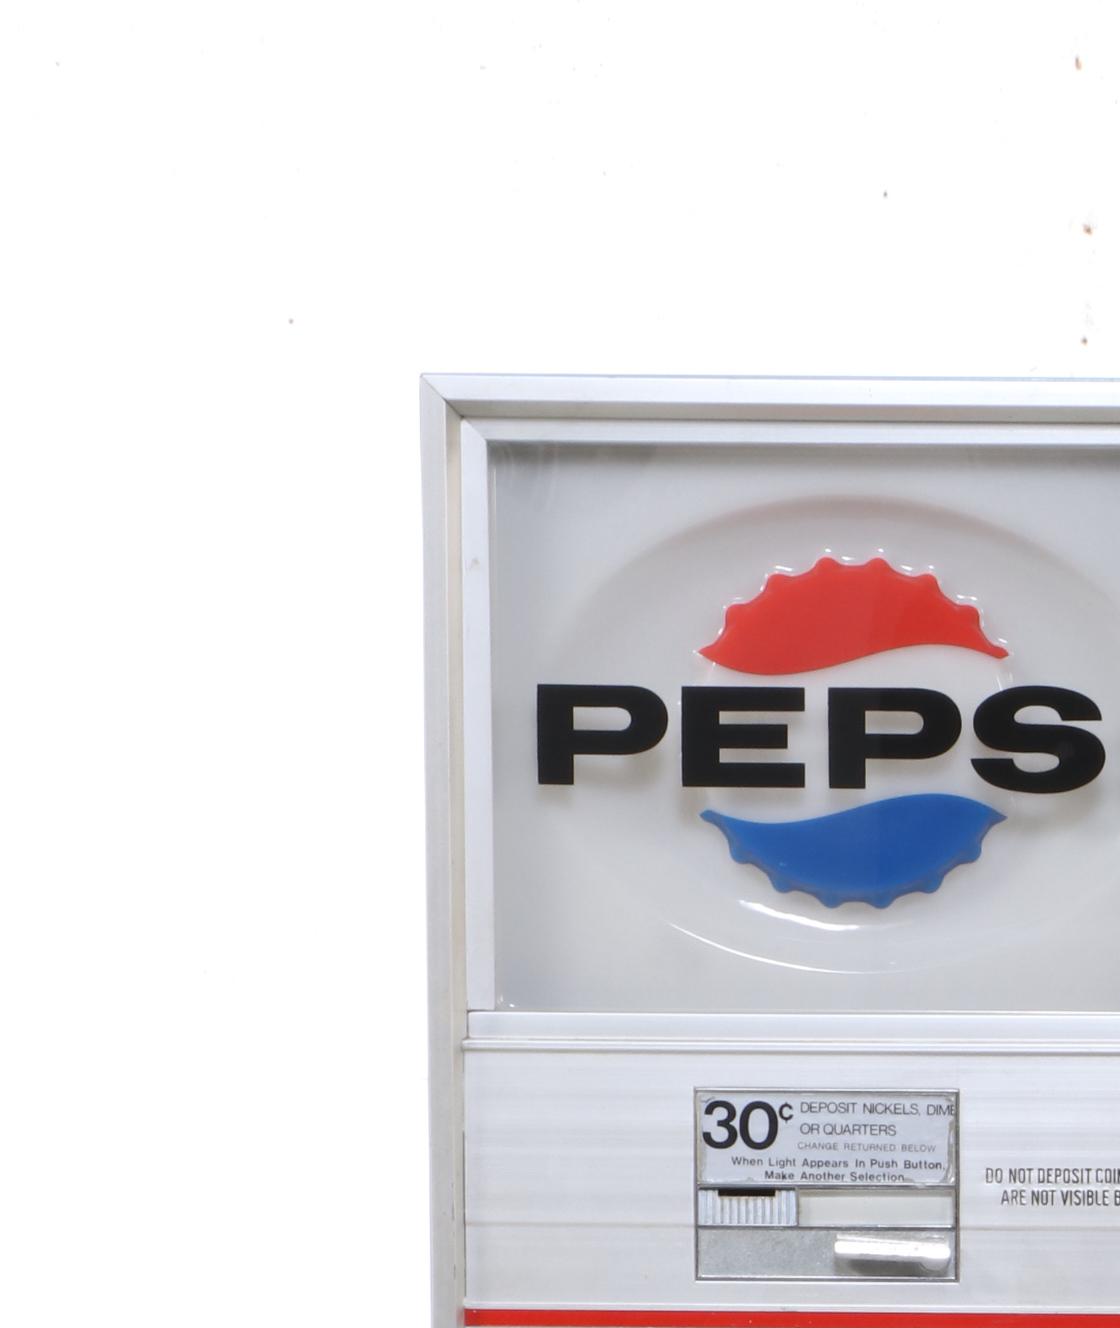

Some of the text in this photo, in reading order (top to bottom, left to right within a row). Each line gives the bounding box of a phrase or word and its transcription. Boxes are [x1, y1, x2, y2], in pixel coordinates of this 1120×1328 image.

[800, 1101, 857, 1114] DEPOSIT
[862, 1102, 921, 1116] NICKELS,
[702, 1100, 794, 1150] 30¢
[800, 1123, 897, 1136] OR QUARTERS
[797, 1141, 936, 1153] CHANGE RETURNED BELOW
[731, 1156, 763, 1166] When
[768, 1157, 796, 1169] Light
[802, 1158, 848, 1169] Appears
[855, 1159, 865, 1168] In
[870, 1159, 898, 1169] Push
[765, 1170, 795, 1180] Make
[800, 1171, 846, 1181] Another
[985, 1167, 1002, 1184] DO
[1008, 1167, 1033, 1184] NOT
[1037, 1167, 1092, 1184] DEPOSIT
[1001, 1189, 1026, 1206] ARE
[1031, 1189, 1056, 1206] NOT
[1060, 1189, 1109, 1206] VISIBLE
